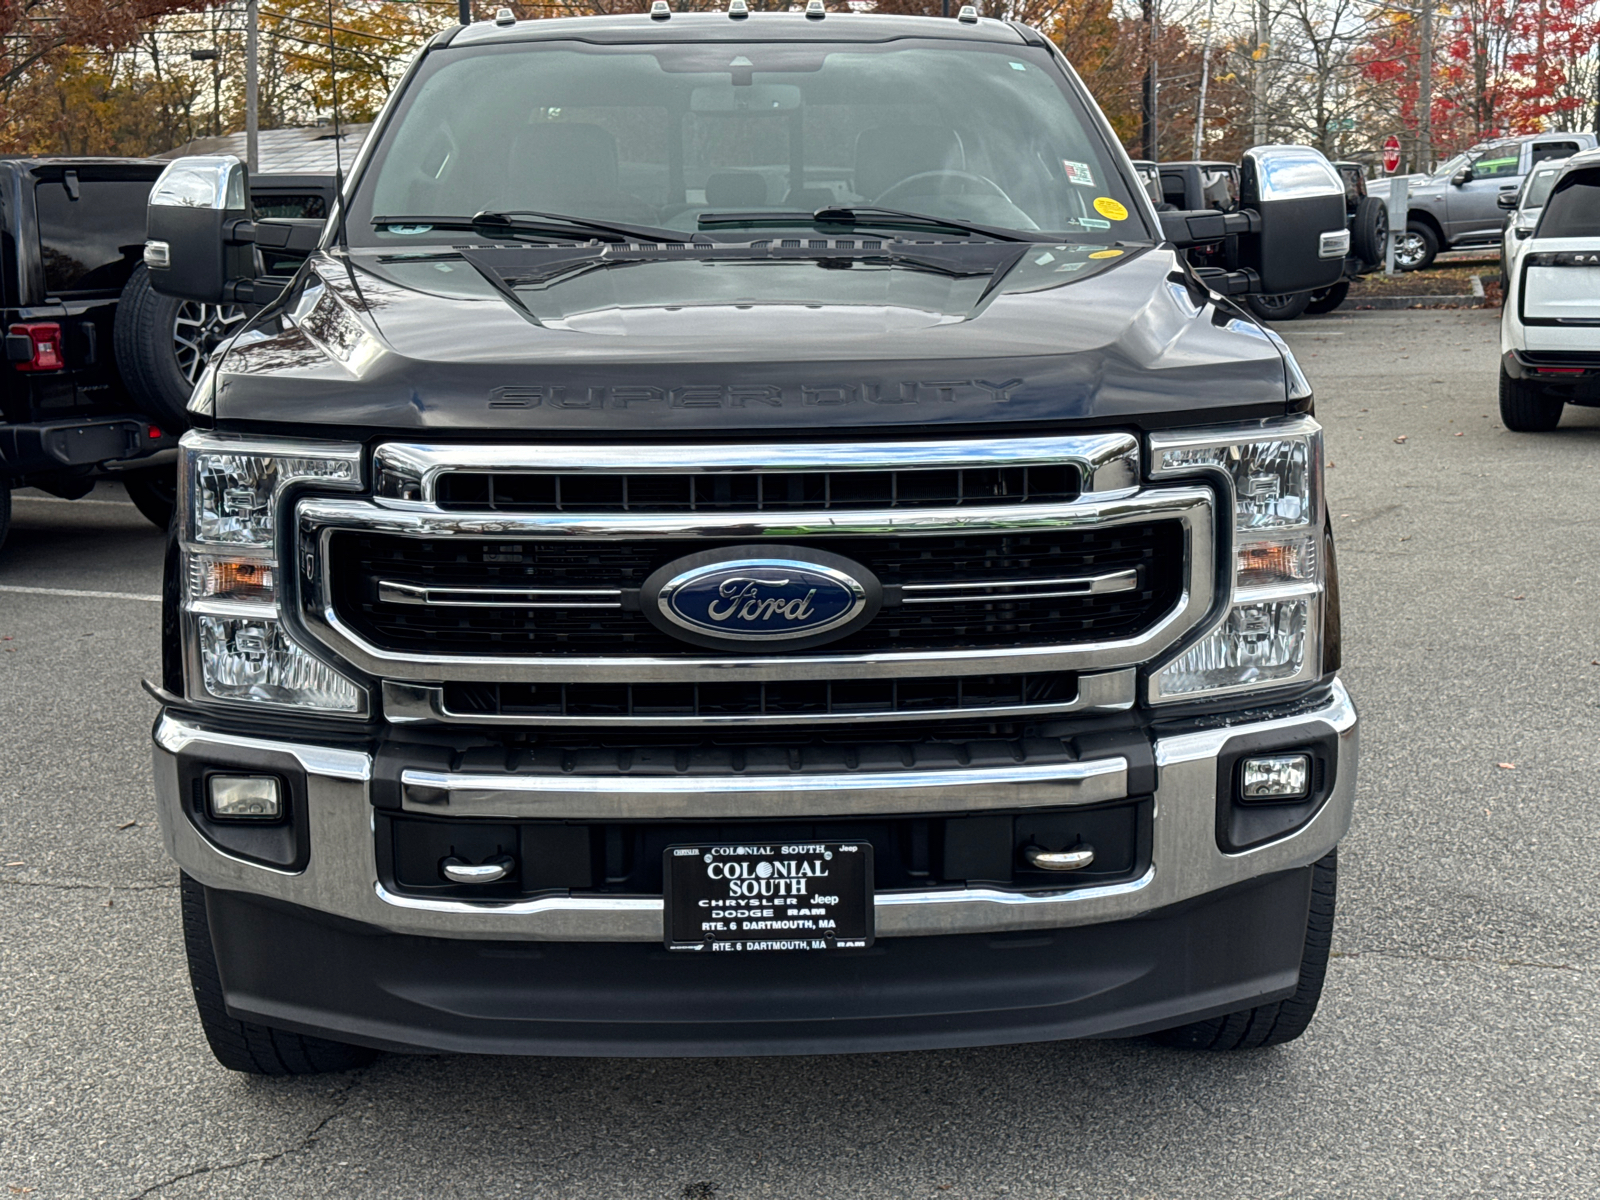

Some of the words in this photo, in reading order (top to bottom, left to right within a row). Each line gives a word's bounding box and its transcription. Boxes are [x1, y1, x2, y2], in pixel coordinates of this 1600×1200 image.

[488, 384, 783, 409] SUPER
[801, 377, 1025, 407] DUTY
[708, 577, 817, 621] Ford
[711, 846, 774, 856] COLONIAL
[781, 844, 825, 855] SOUTH
[839, 844, 858, 853] Jeep
[707, 860, 829, 879] COLONIAL
[729, 878, 808, 897] SOUTH
[698, 897, 798, 907] CHRYSLER
[810, 893, 839, 906] Jeep
[711, 909, 774, 918] DODGE
[787, 908, 826, 916] RAM
[701, 921, 727, 931] RTE.
[729, 921, 738, 930] 6
[742, 920, 816, 930] DARTMOUTH,
[818, 919, 836, 929] MA
[712, 942, 734, 951] RTE.
[736, 942, 743, 951] 6
[746, 940, 810, 951] DARTMOUTH,
[811, 940, 827, 949] MA
